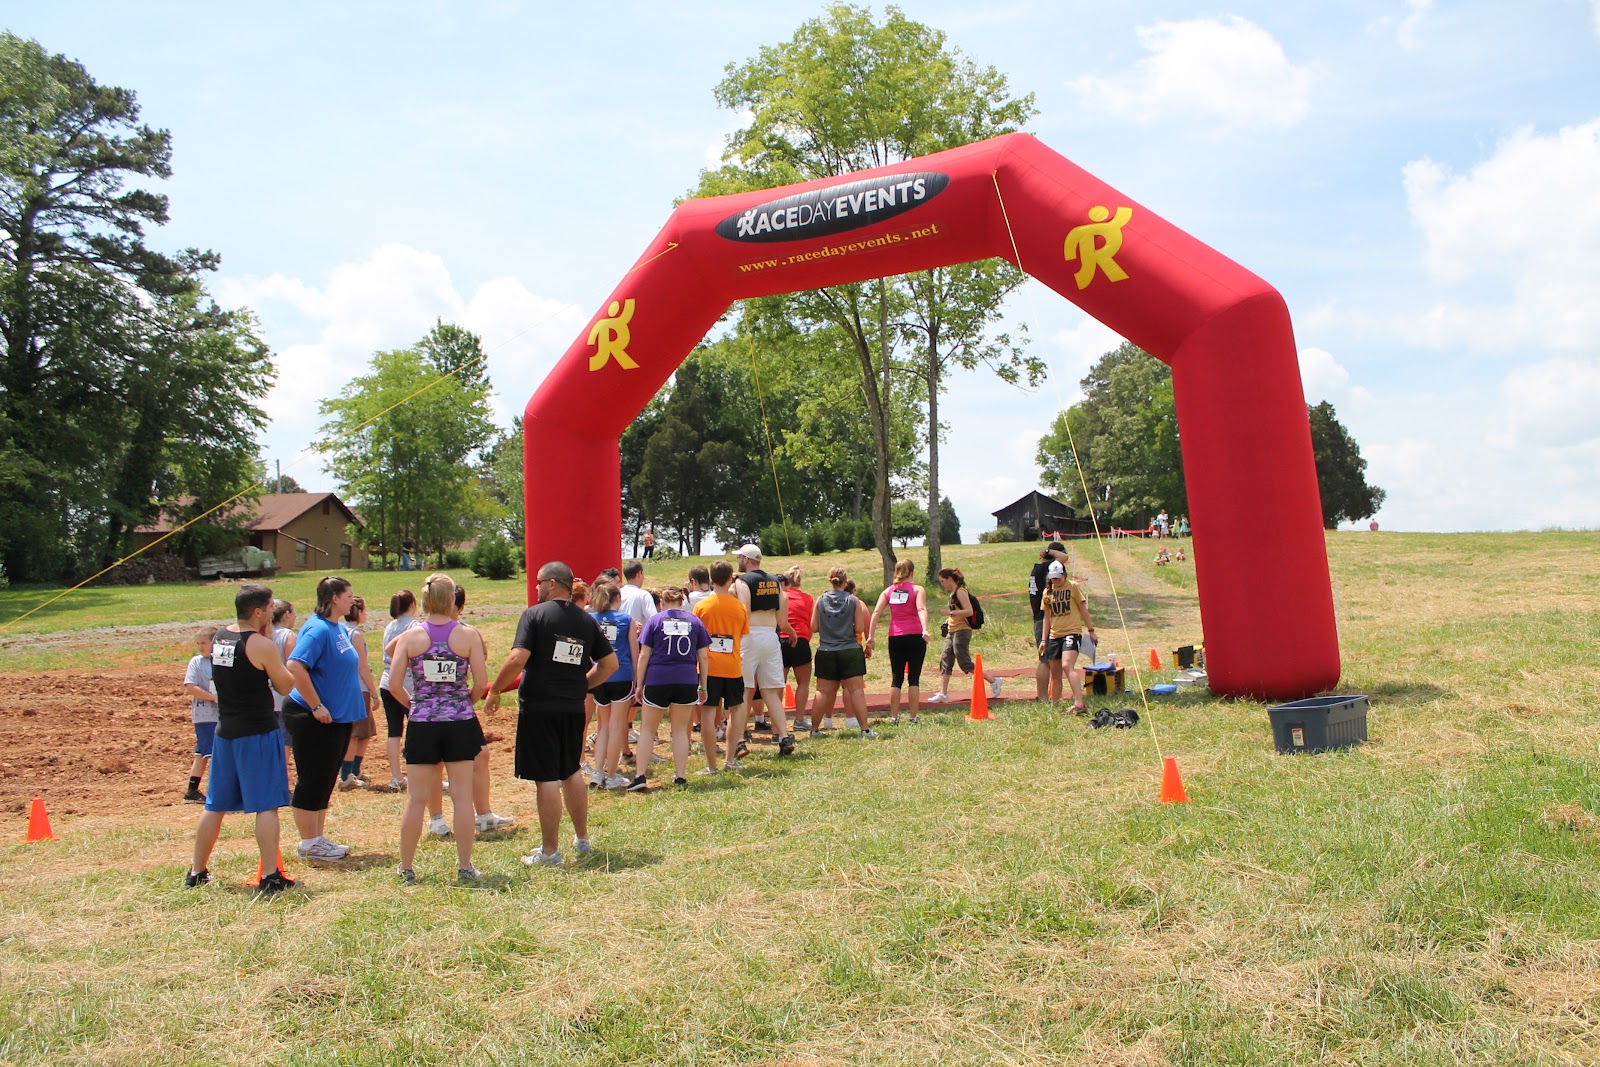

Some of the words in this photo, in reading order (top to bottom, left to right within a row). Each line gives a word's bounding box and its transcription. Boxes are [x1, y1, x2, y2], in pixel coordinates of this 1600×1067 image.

[1049, 601, 1071, 616] UN
[673, 622, 679, 630] 4
[663, 634, 692, 656] 10
[718, 638, 724, 647] 4
[1065, 635, 1075, 645] 5
